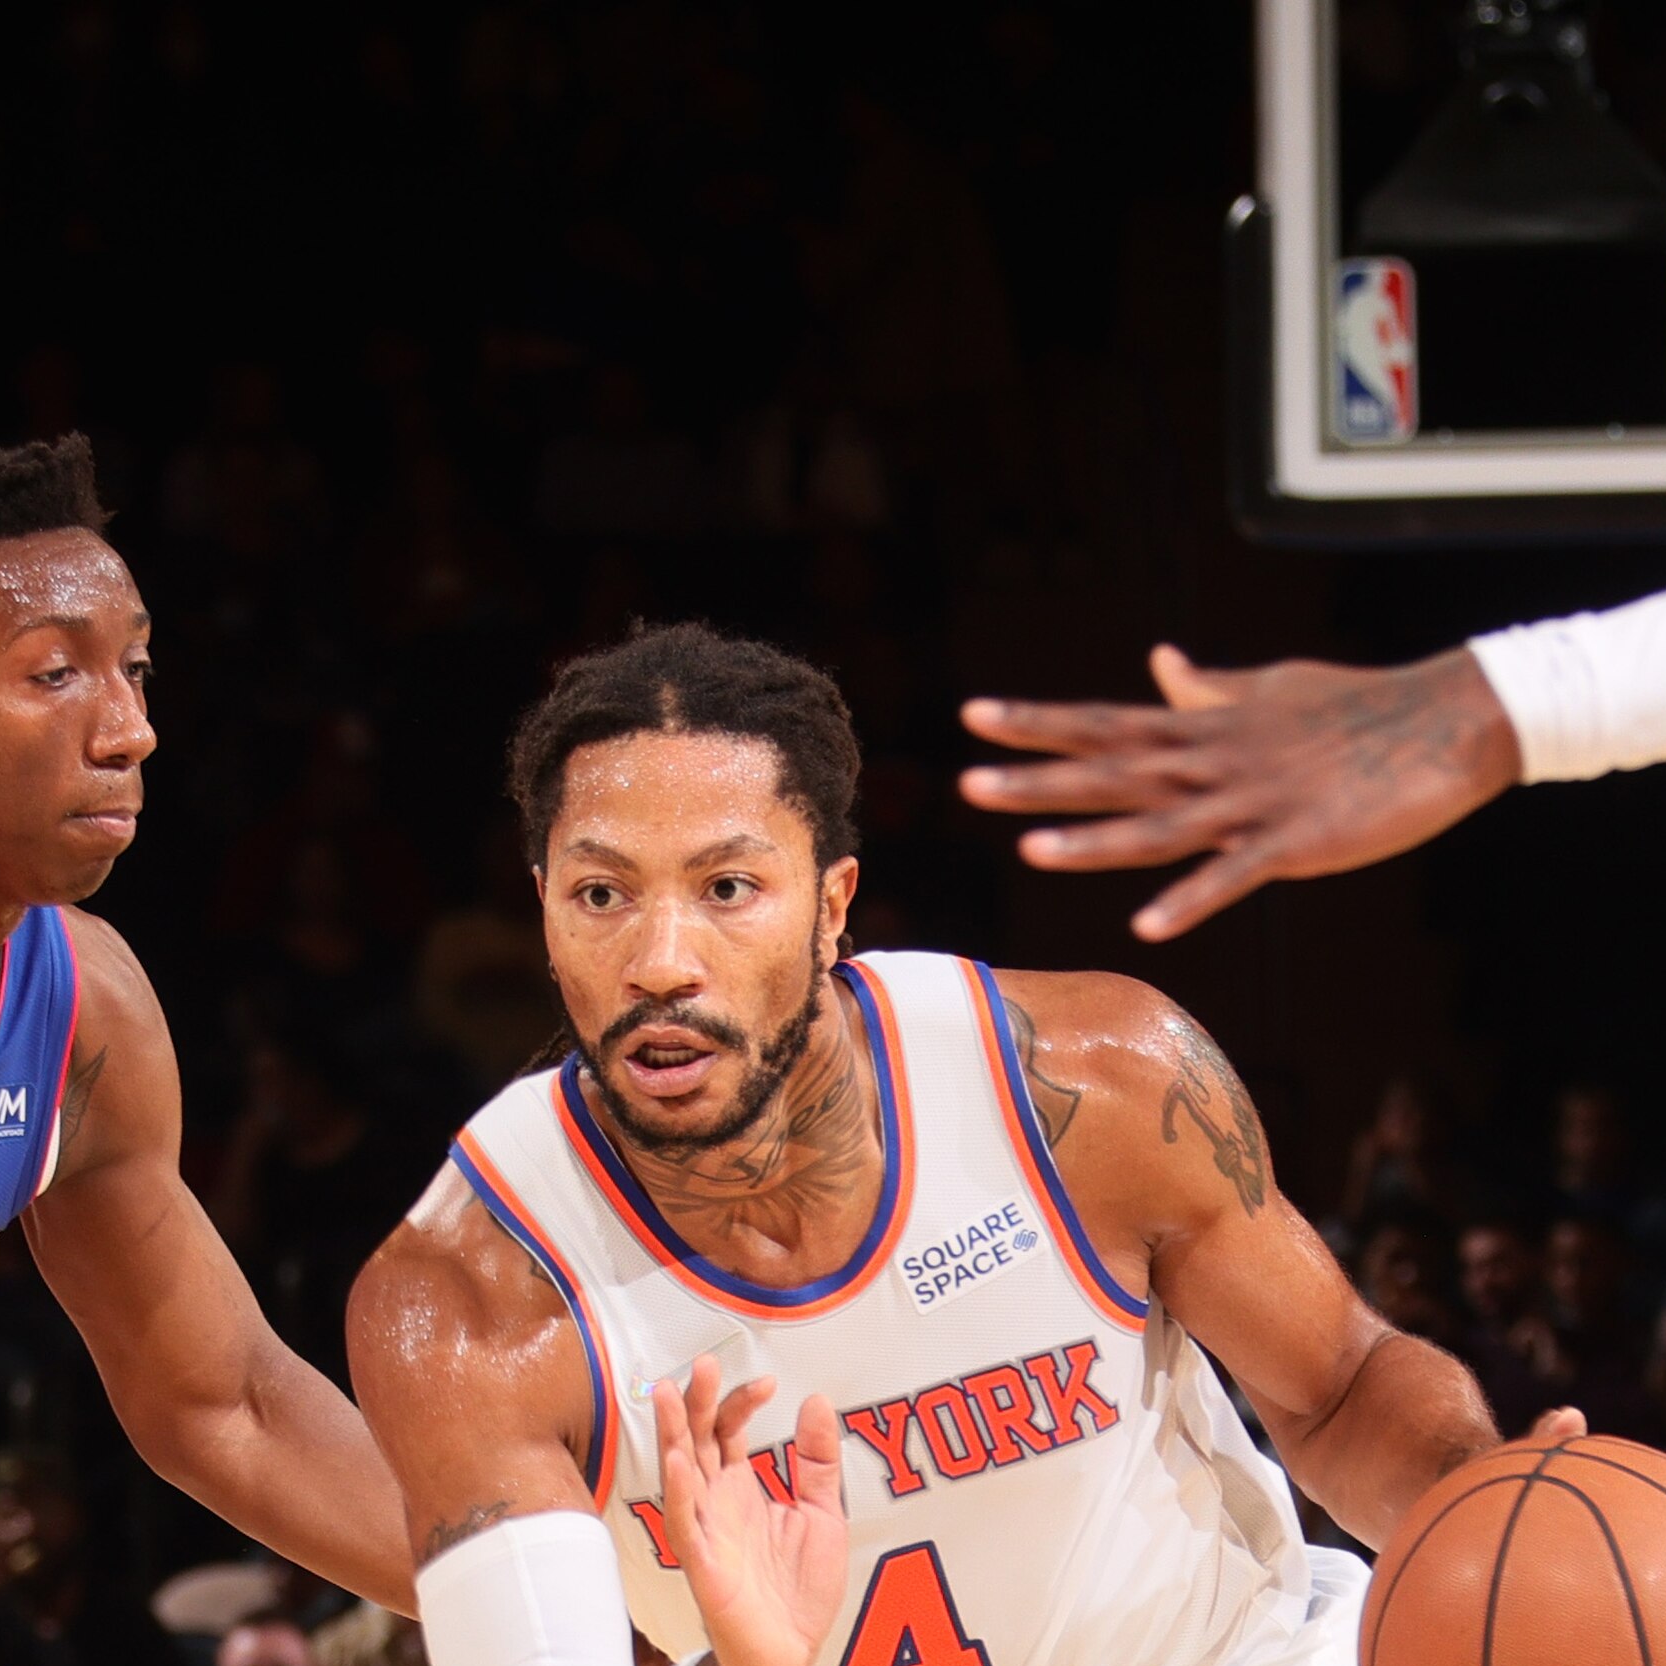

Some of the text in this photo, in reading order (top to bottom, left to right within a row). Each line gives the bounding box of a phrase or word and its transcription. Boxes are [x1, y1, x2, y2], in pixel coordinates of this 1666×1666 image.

[903, 1202, 1024, 1280] SQUARE
[914, 1241, 1014, 1305] SPACE
[844, 1338, 1120, 1498] YORK
